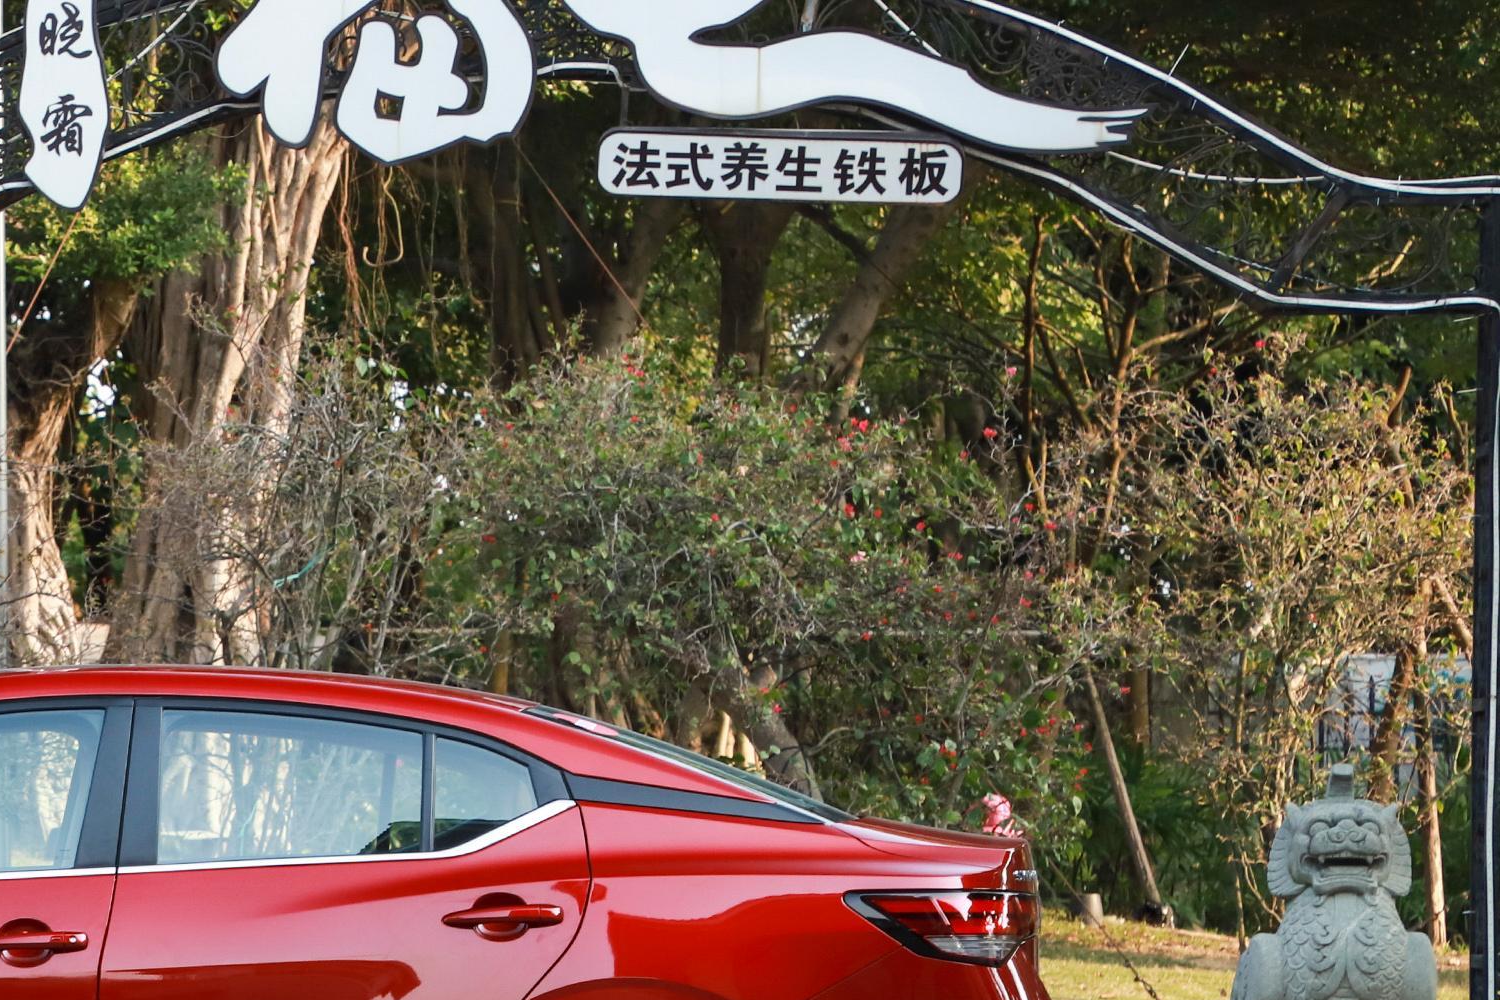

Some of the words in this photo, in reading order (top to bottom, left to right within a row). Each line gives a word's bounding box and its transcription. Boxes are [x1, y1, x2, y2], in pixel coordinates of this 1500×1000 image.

[38, 1, 93, 157] 晓霜
[611, 140, 950, 196] 法式养生铁板
